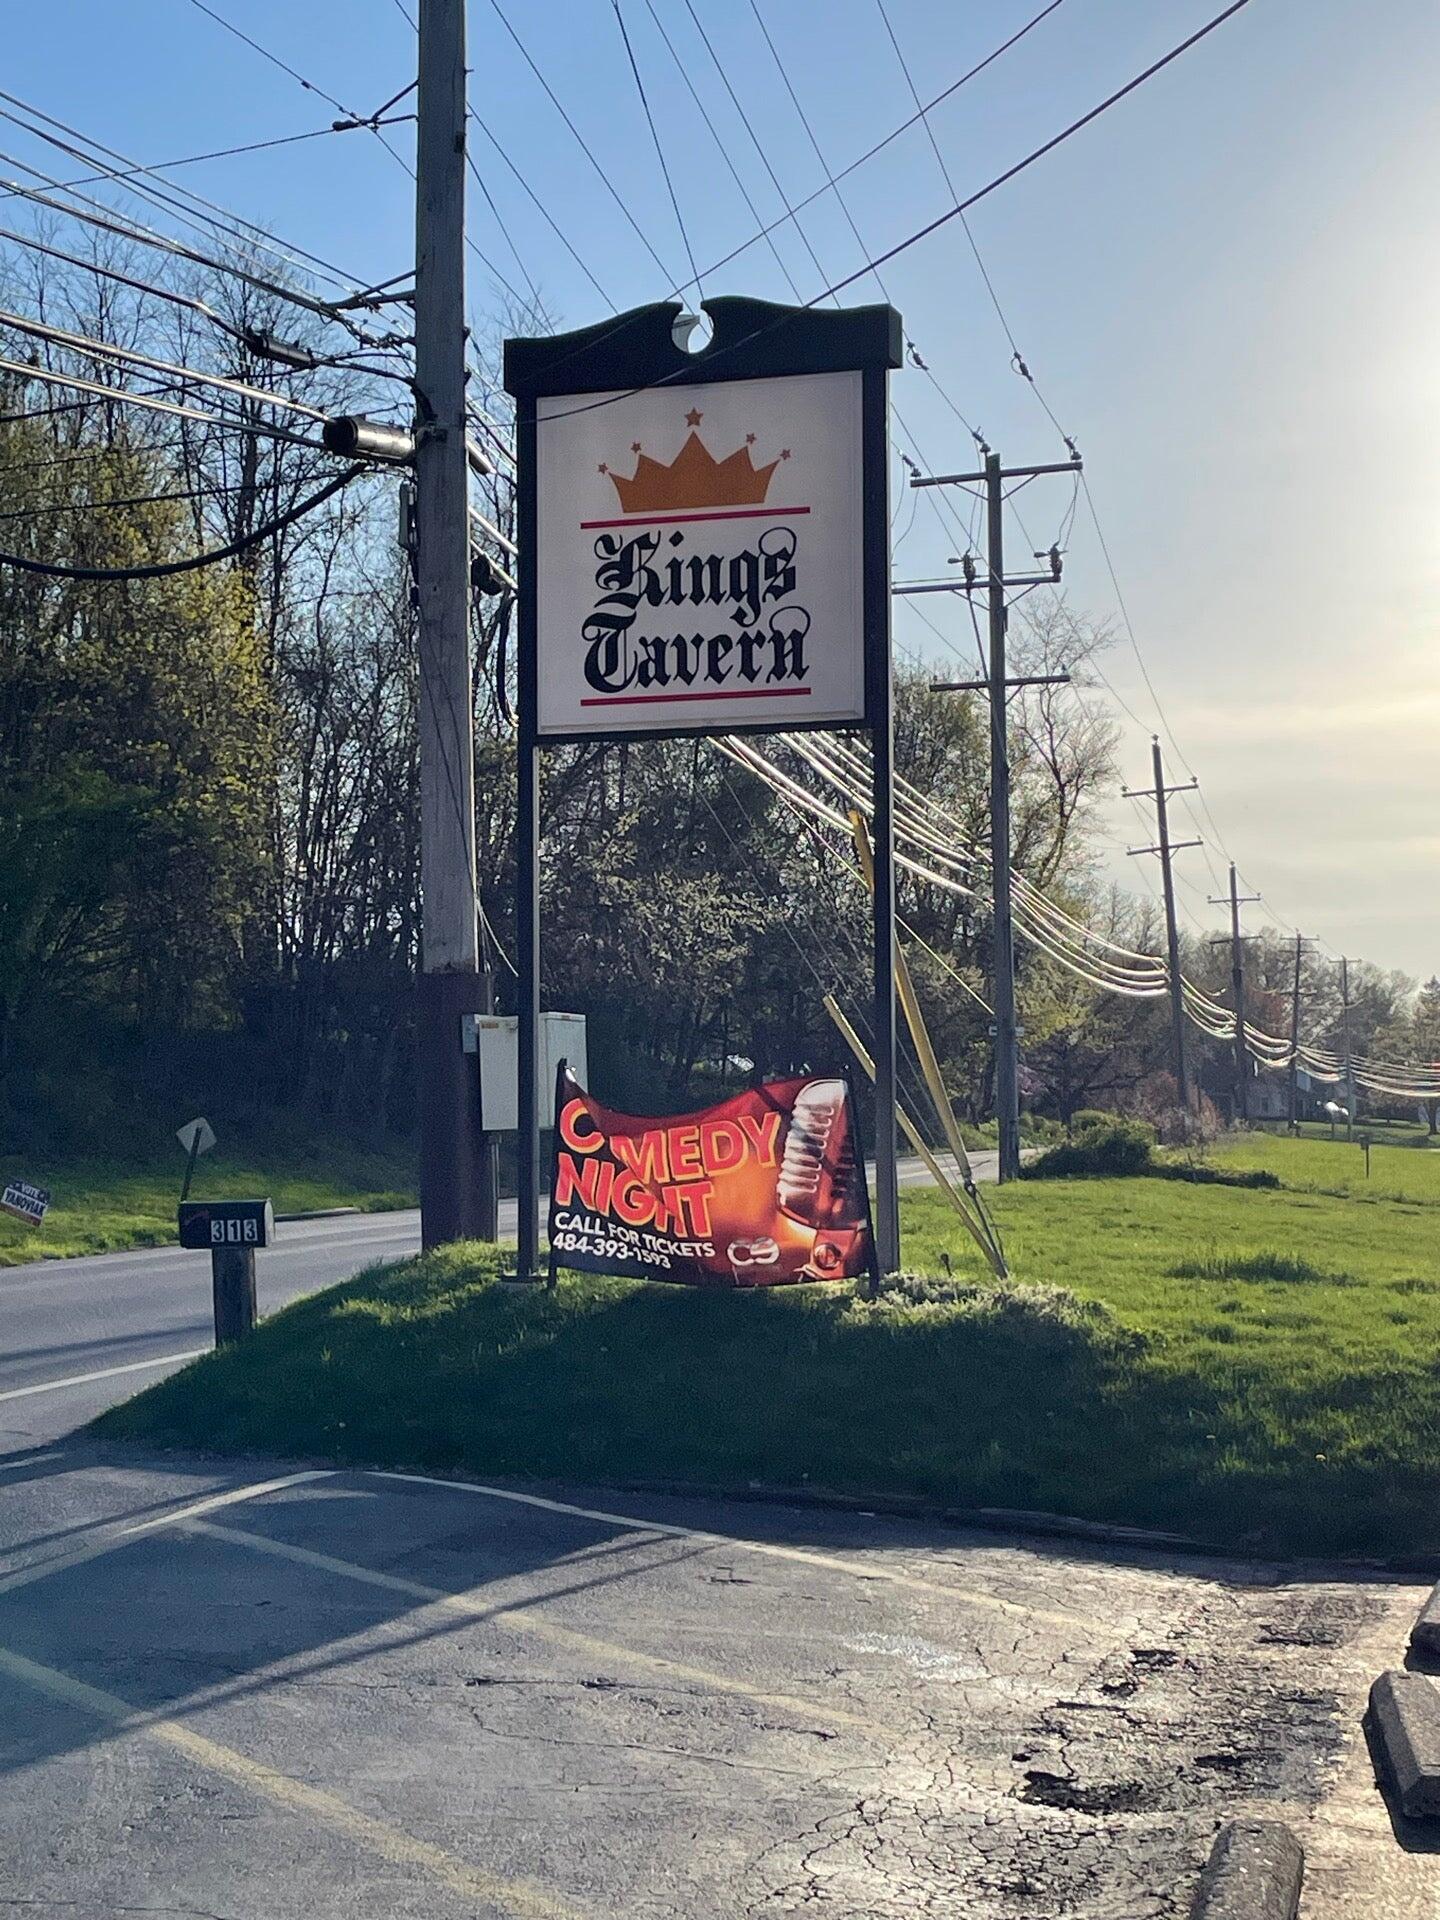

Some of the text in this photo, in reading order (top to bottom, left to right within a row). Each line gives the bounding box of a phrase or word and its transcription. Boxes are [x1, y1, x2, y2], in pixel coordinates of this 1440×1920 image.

[594, 526, 797, 627] Kings
[581, 605, 811, 693] Tavern
[21, 1182, 41, 1199] VOTE
[555, 1152, 714, 1238] NIGHT
[212, 1220, 257, 1241] 313
[552, 1232, 671, 1269] 484-393-1593
[554, 1211, 605, 1236] CALL
[607, 1222, 642, 1247] FOR
[641, 1233, 716, 1257] TICKETS
